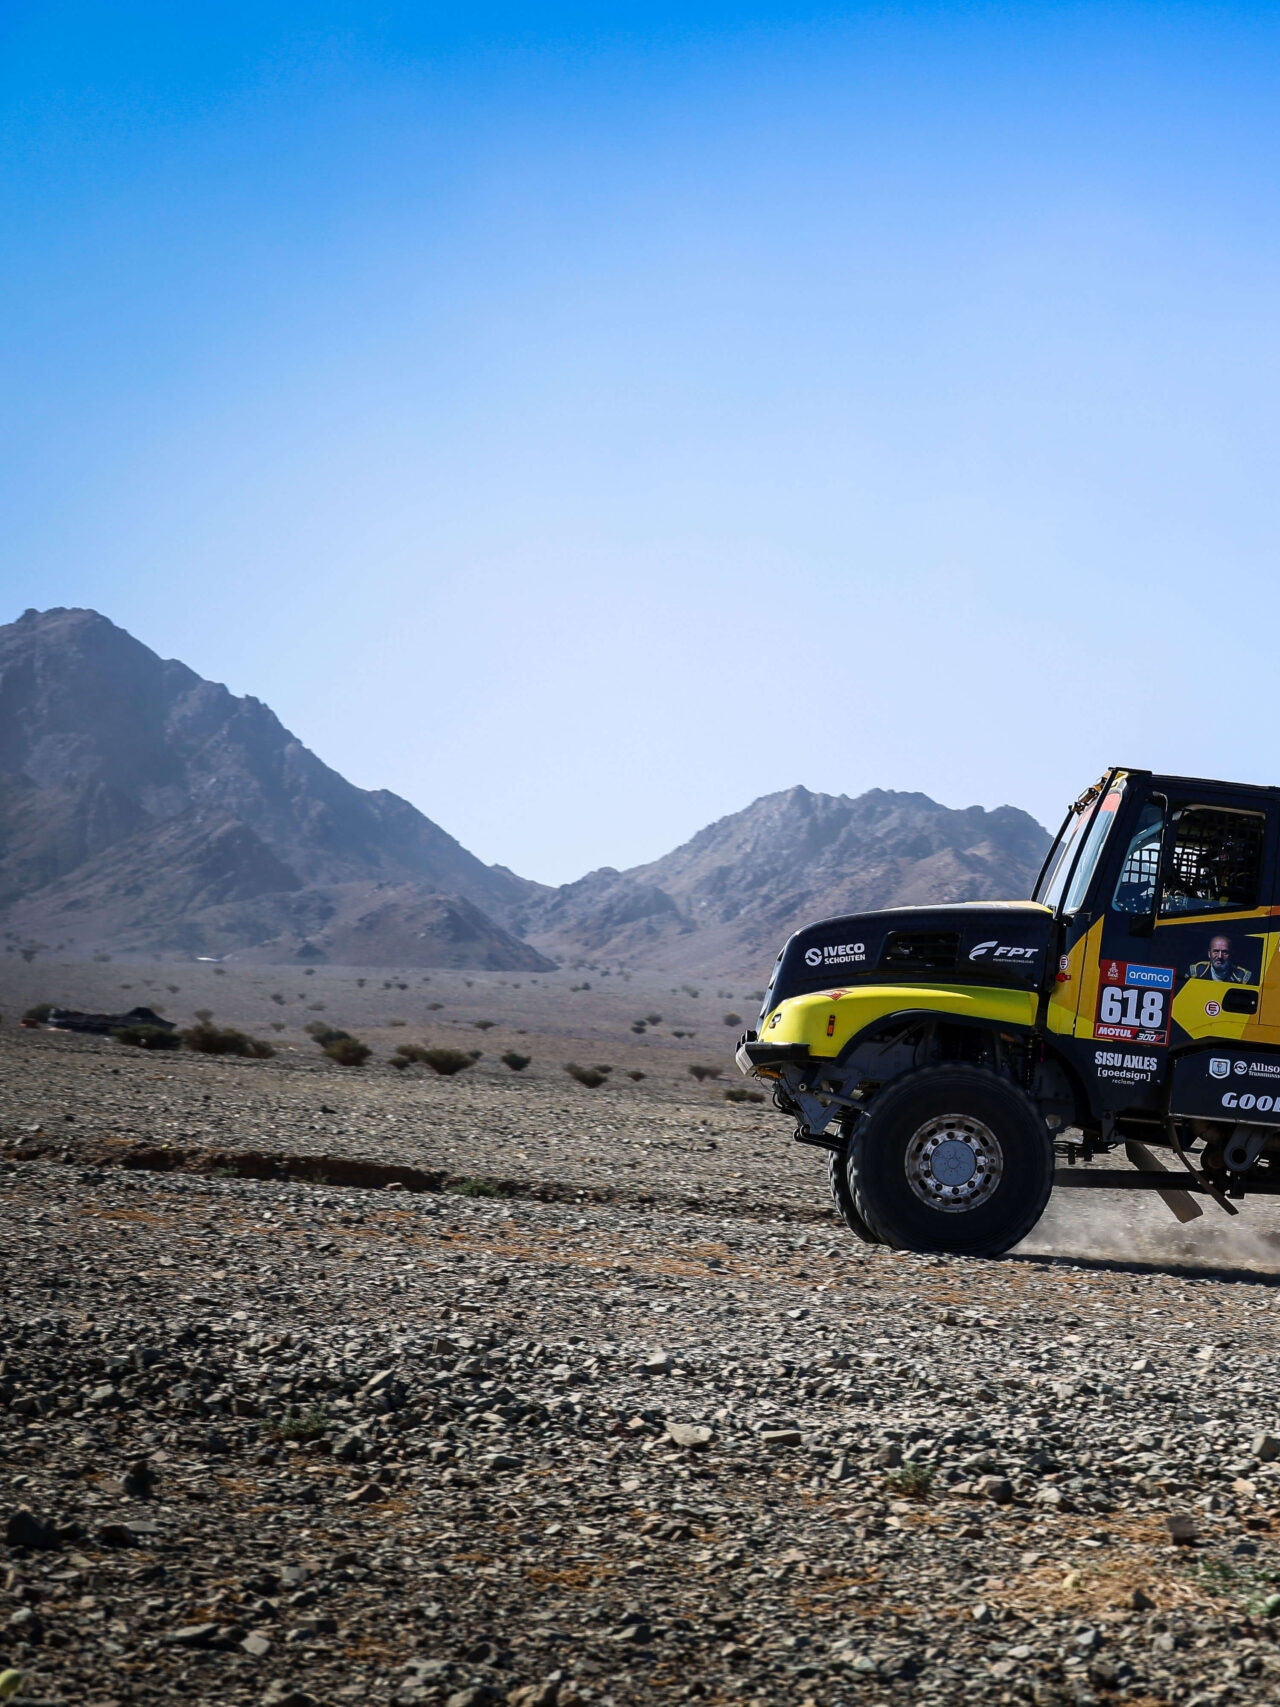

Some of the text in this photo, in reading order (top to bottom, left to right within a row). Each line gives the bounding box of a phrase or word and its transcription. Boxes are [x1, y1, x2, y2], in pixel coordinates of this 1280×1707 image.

[823, 943, 865, 957] IVECO
[993, 946, 1039, 958] FPT
[824, 954, 866, 965] SCHOUTEN
[1128, 971, 1170, 982] aramco
[1100, 986, 1164, 1028] 618
[1098, 1026, 1133, 1037] MOTUL
[1094, 1051, 1158, 1071] SISU AXLES
